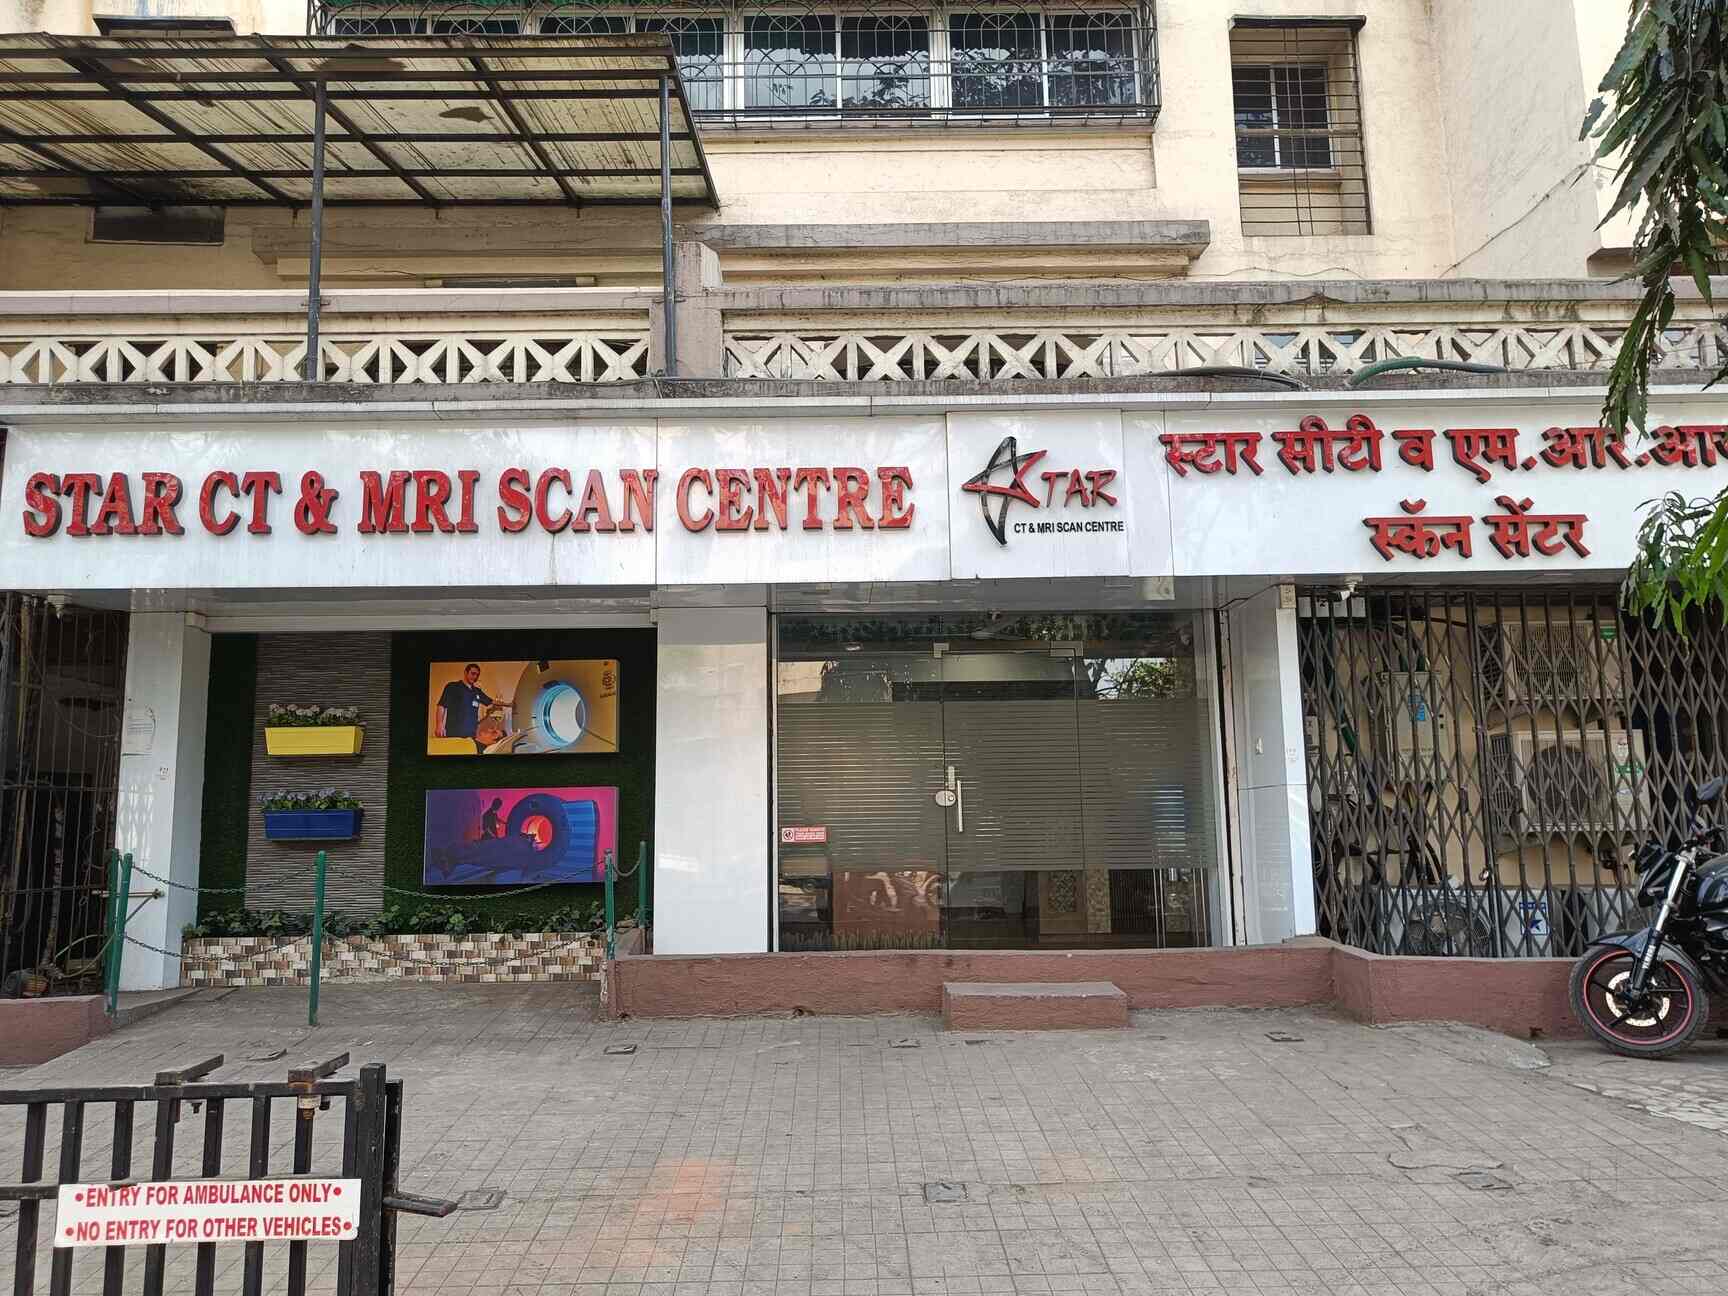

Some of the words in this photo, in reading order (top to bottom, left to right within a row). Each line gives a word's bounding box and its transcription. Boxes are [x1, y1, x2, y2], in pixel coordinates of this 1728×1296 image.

[1159, 432, 1264, 477] स्टार
[1272, 414, 1384, 474] सीटी
[1391, 429, 1435, 472] व
[23, 471, 185, 537] STAR
[199, 470, 283, 536] CT
[293, 469, 340, 534] &
[357, 469, 480, 534] MRI
[497, 468, 658, 533] SCAN
[676, 466, 915, 532] CENTRE
[1014, 523, 1027, 533] CT
[1028, 523, 1035, 533] &
[1037, 522, 1055, 533] MRI
[1057, 522, 1083, 532] SCAN
[1085, 520, 1124, 532] CENTRE
[1363, 498, 1473, 561] स्कॅन
[86, 1186, 140, 1208] ENTRY
[146, 1186, 179, 1206] FOR
[183, 1183, 285, 1205] AMBULANCE
[288, 1182, 331, 1203] ONLY
[76, 1220, 101, 1242] NO
[105, 1218, 160, 1240] ENTRY
[165, 1218, 197, 1239] FOR
[202, 1217, 258, 1238] OTHER
[262, 1216, 341, 1236] VEHICLES
